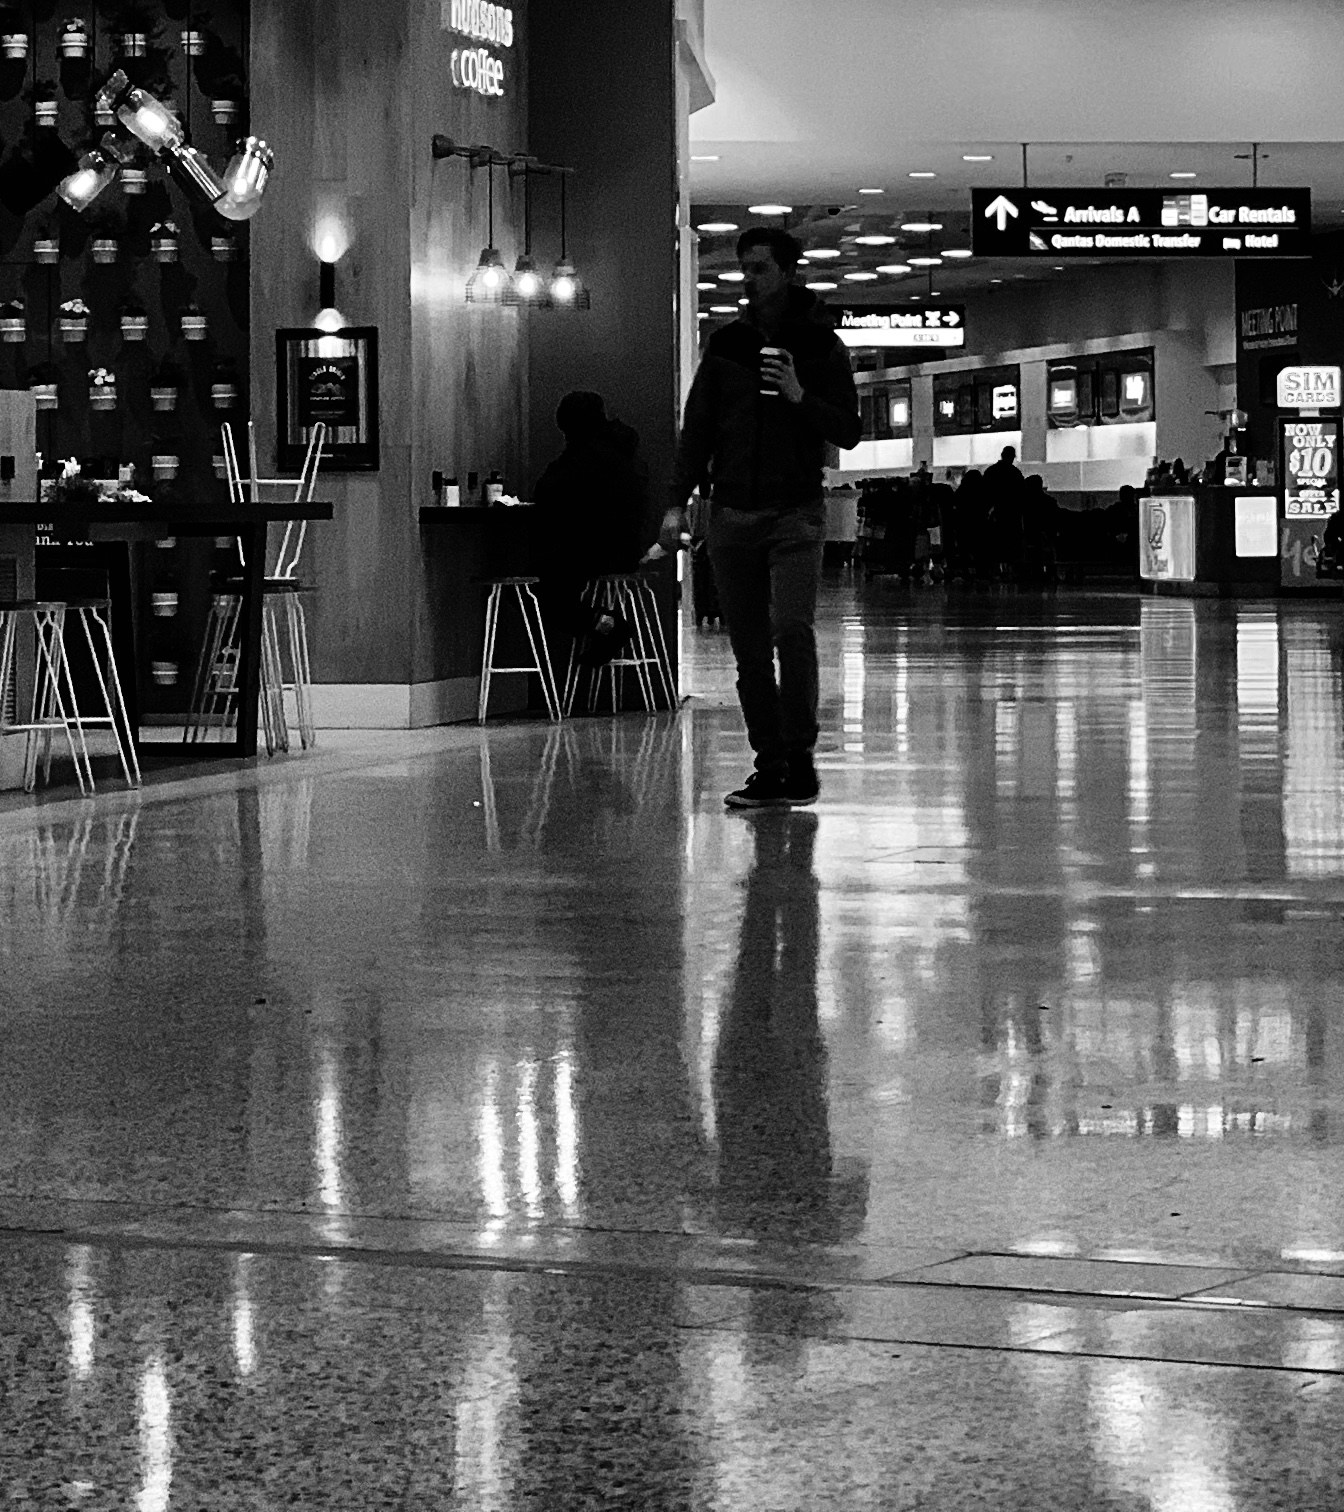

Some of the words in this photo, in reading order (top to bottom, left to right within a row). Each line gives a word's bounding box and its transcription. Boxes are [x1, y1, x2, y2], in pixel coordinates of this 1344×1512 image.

[460, 48, 504, 96] coffee
[1064, 205, 1125, 224] Arrivals
[1126, 207, 1140, 224] A
[1208, 206, 1236, 224] Car
[1238, 206, 1296, 224] Rentals
[1051, 234, 1094, 249] Qantas
[1095, 233, 1150, 248] Domestic
[1152, 234, 1202, 248] Transfer
[1245, 233, 1279, 248] Hotel
[842, 314, 890, 329] Meeting
[890, 313, 923, 327] Point
[1241, 307, 1274, 336] MEETING
[1274, 303, 1298, 333] POINT
[1284, 372, 1335, 391] SIM
[1284, 392, 1336, 403] CARDS
[1284, 424, 1323, 437] NOW
[1293, 434, 1337, 447] ONLY
[1288, 447, 1333, 477] $10
[1288, 501, 1337, 513] SALE
